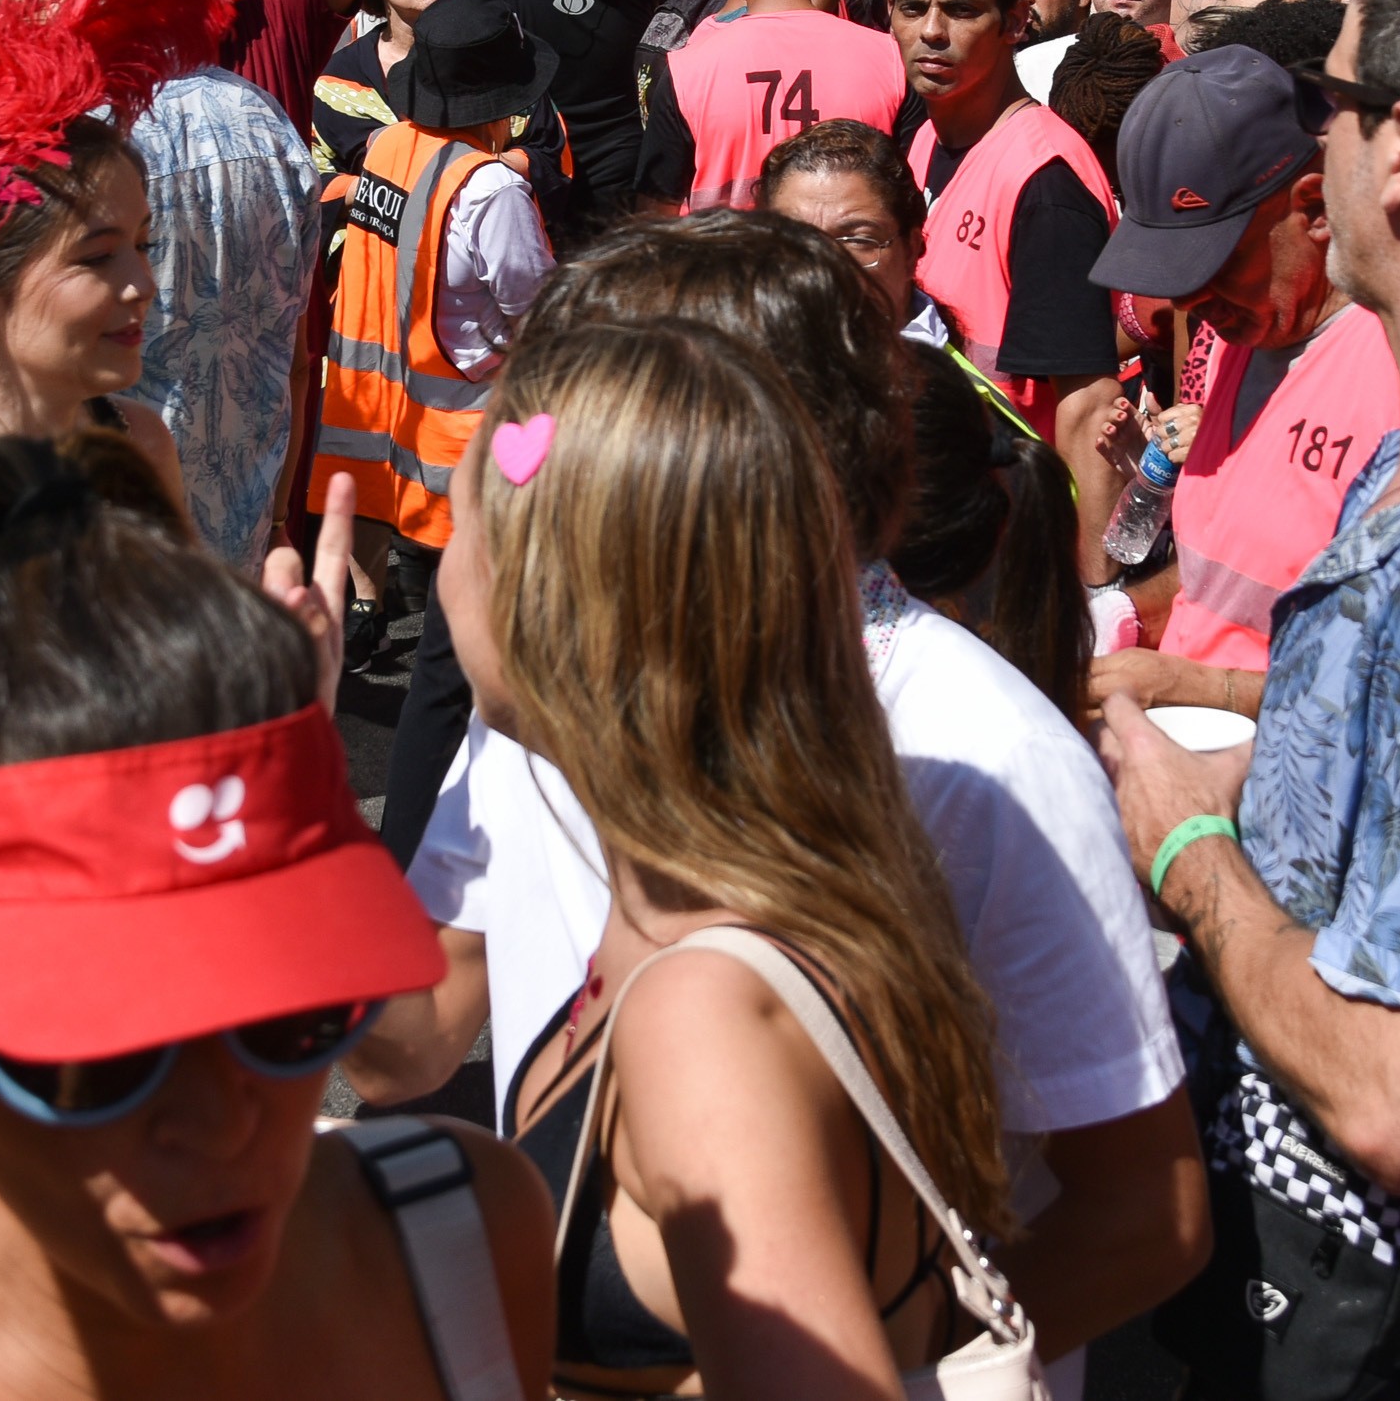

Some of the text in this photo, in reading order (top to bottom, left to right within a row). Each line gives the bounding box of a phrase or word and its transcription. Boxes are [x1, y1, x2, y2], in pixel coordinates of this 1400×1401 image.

[745, 69, 820, 135] 74
[355, 176, 405, 221] FAQUI
[956, 209, 986, 251] 82
[1288, 418, 1354, 479] 181
